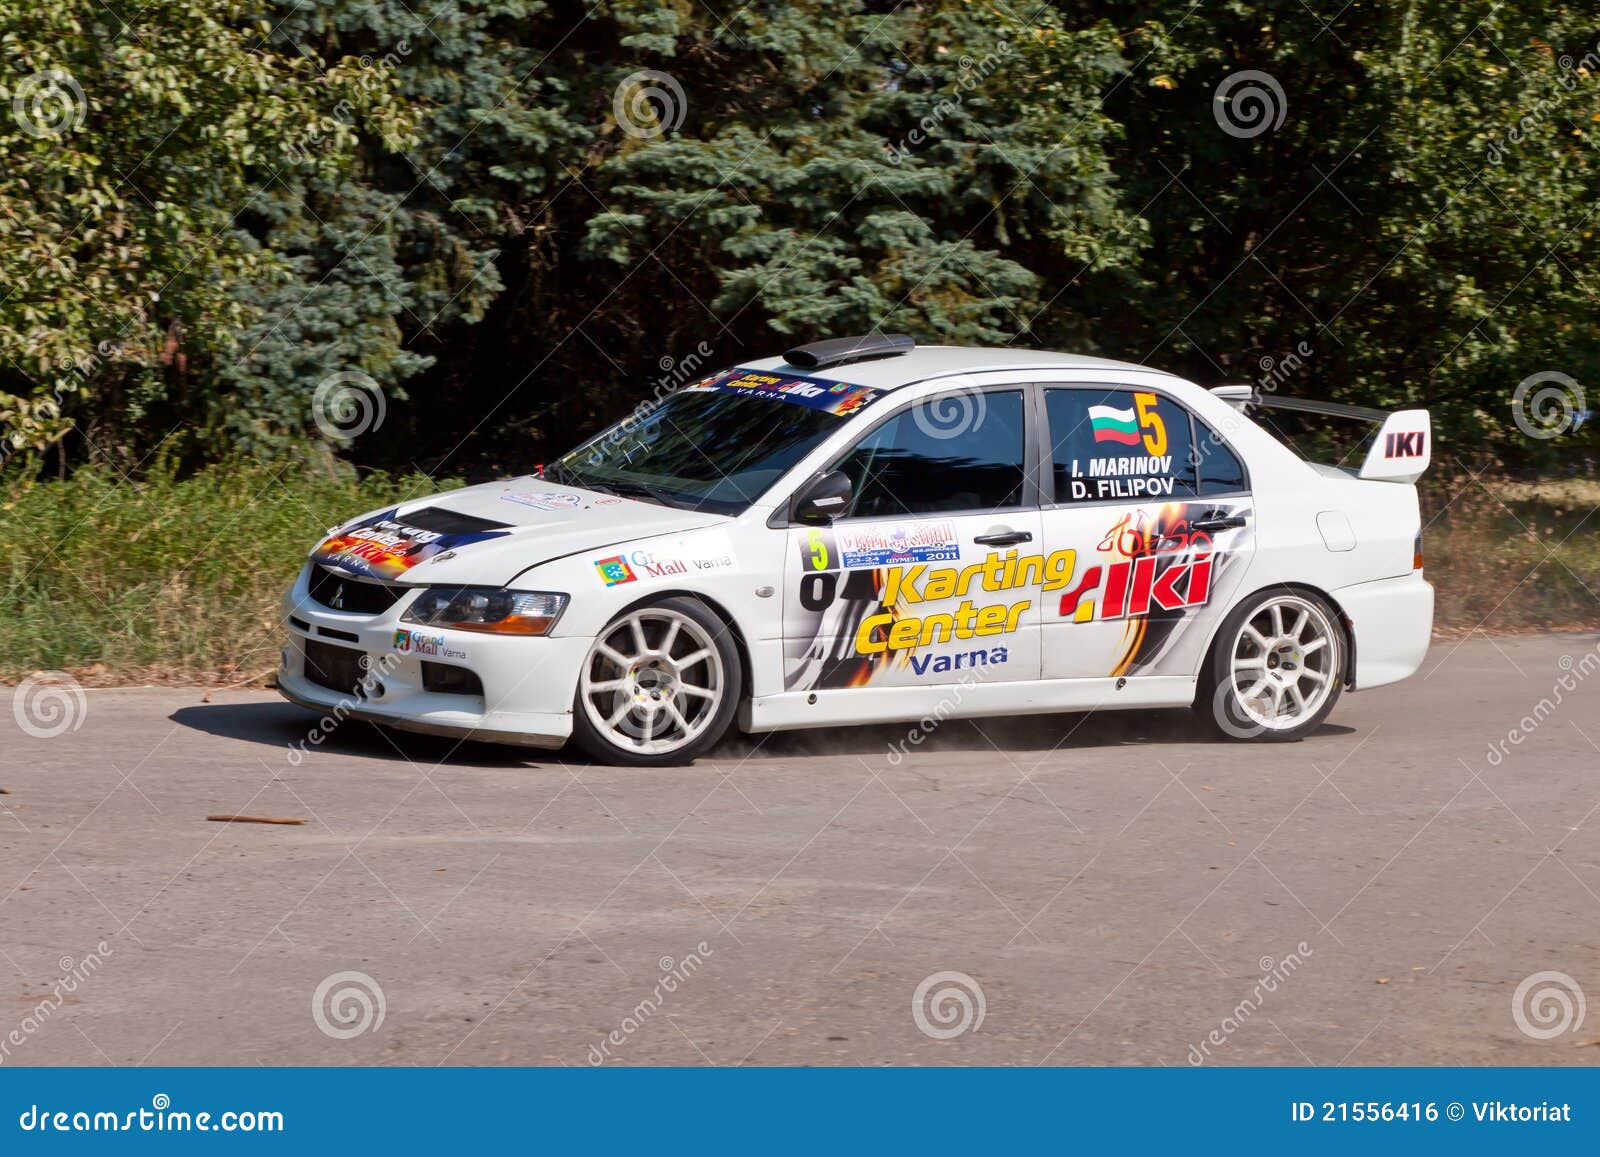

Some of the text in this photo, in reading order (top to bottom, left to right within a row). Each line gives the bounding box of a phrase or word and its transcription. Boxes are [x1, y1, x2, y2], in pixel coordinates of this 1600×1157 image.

[736, 387, 788, 400] VARNA
[1133, 391, 1168, 457] 5
[1384, 431, 1425, 459] IKI
[1071, 455, 1172, 478] I. MARINOV
[1071, 476, 1175, 499] D. FILIPOV
[807, 527, 829, 571] 5
[926, 552, 959, 562] 2011
[327, 553, 372, 572] VARNA
[645, 559, 689, 578] Mall
[881, 548, 1077, 608] Karting
[854, 599, 1032, 655] Center
[909, 646, 1009, 676] Varna
